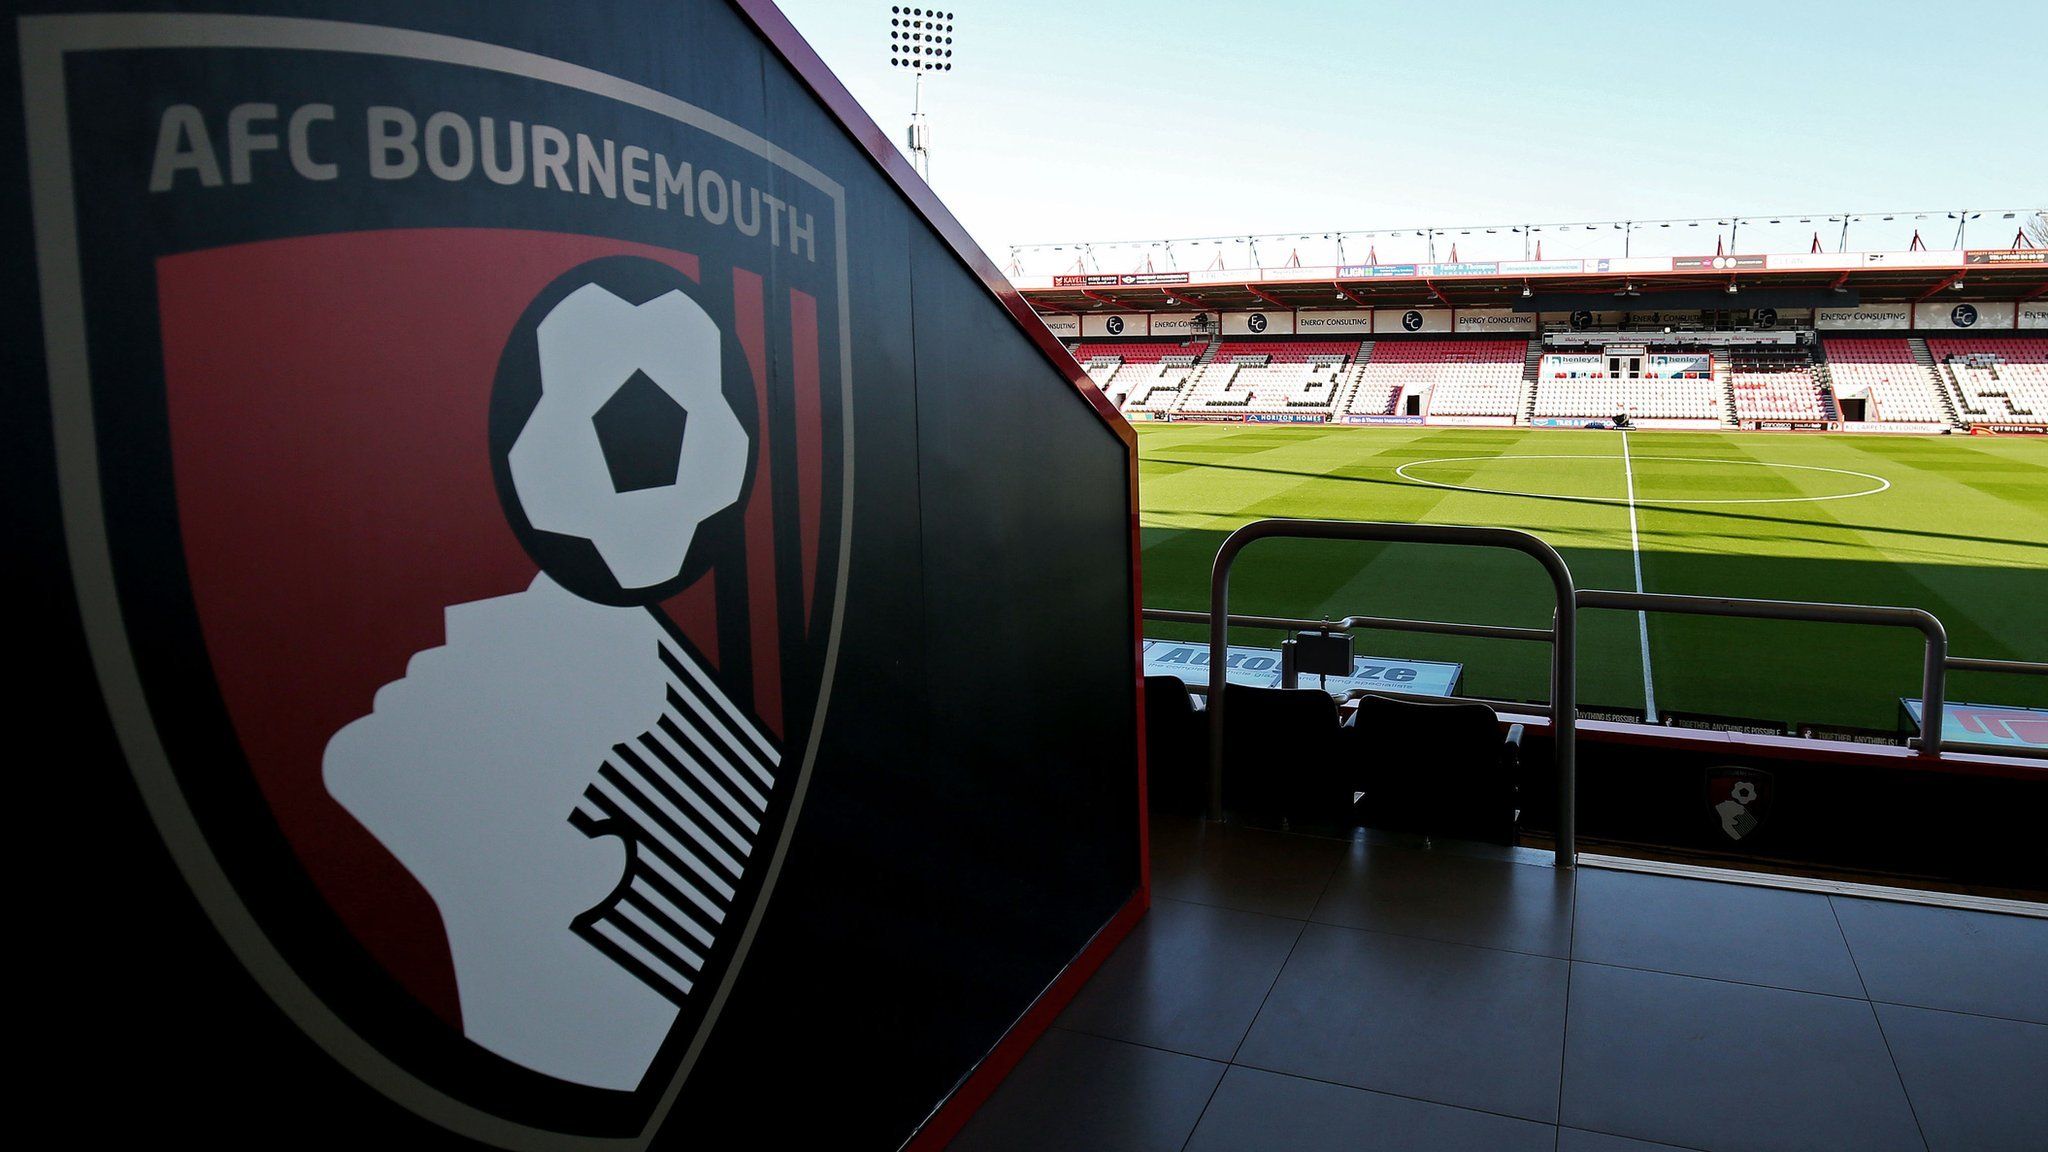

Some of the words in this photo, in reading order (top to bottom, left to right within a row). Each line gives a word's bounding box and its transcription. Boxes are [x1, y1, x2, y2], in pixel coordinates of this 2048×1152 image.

[149, 102, 341, 192] AFC
[367, 105, 815, 263] BOURNEMOUTH
[1821, 312, 1852, 321] ENERGY
[1853, 312, 1906, 320] CONSULTING
[2024, 311, 2048, 319] ENER
[1155, 320, 1177, 328] ENERGY
[1327, 318, 1367, 326] CONSULTING
[1487, 316, 1532, 324] CONSULTING
[1048, 322, 1076, 330] NSULTING
[1563, 356, 1600, 364] henley's
[1669, 356, 1708, 364] henley's
[1612, 714, 1640, 724] POSSIBLE
[1712, 723, 1743, 732] ANYTHING
[1744, 726, 1751, 734] IS
[1751, 727, 1781, 737] POSSIBLE
[1854, 735, 1887, 745] ANYTHING
